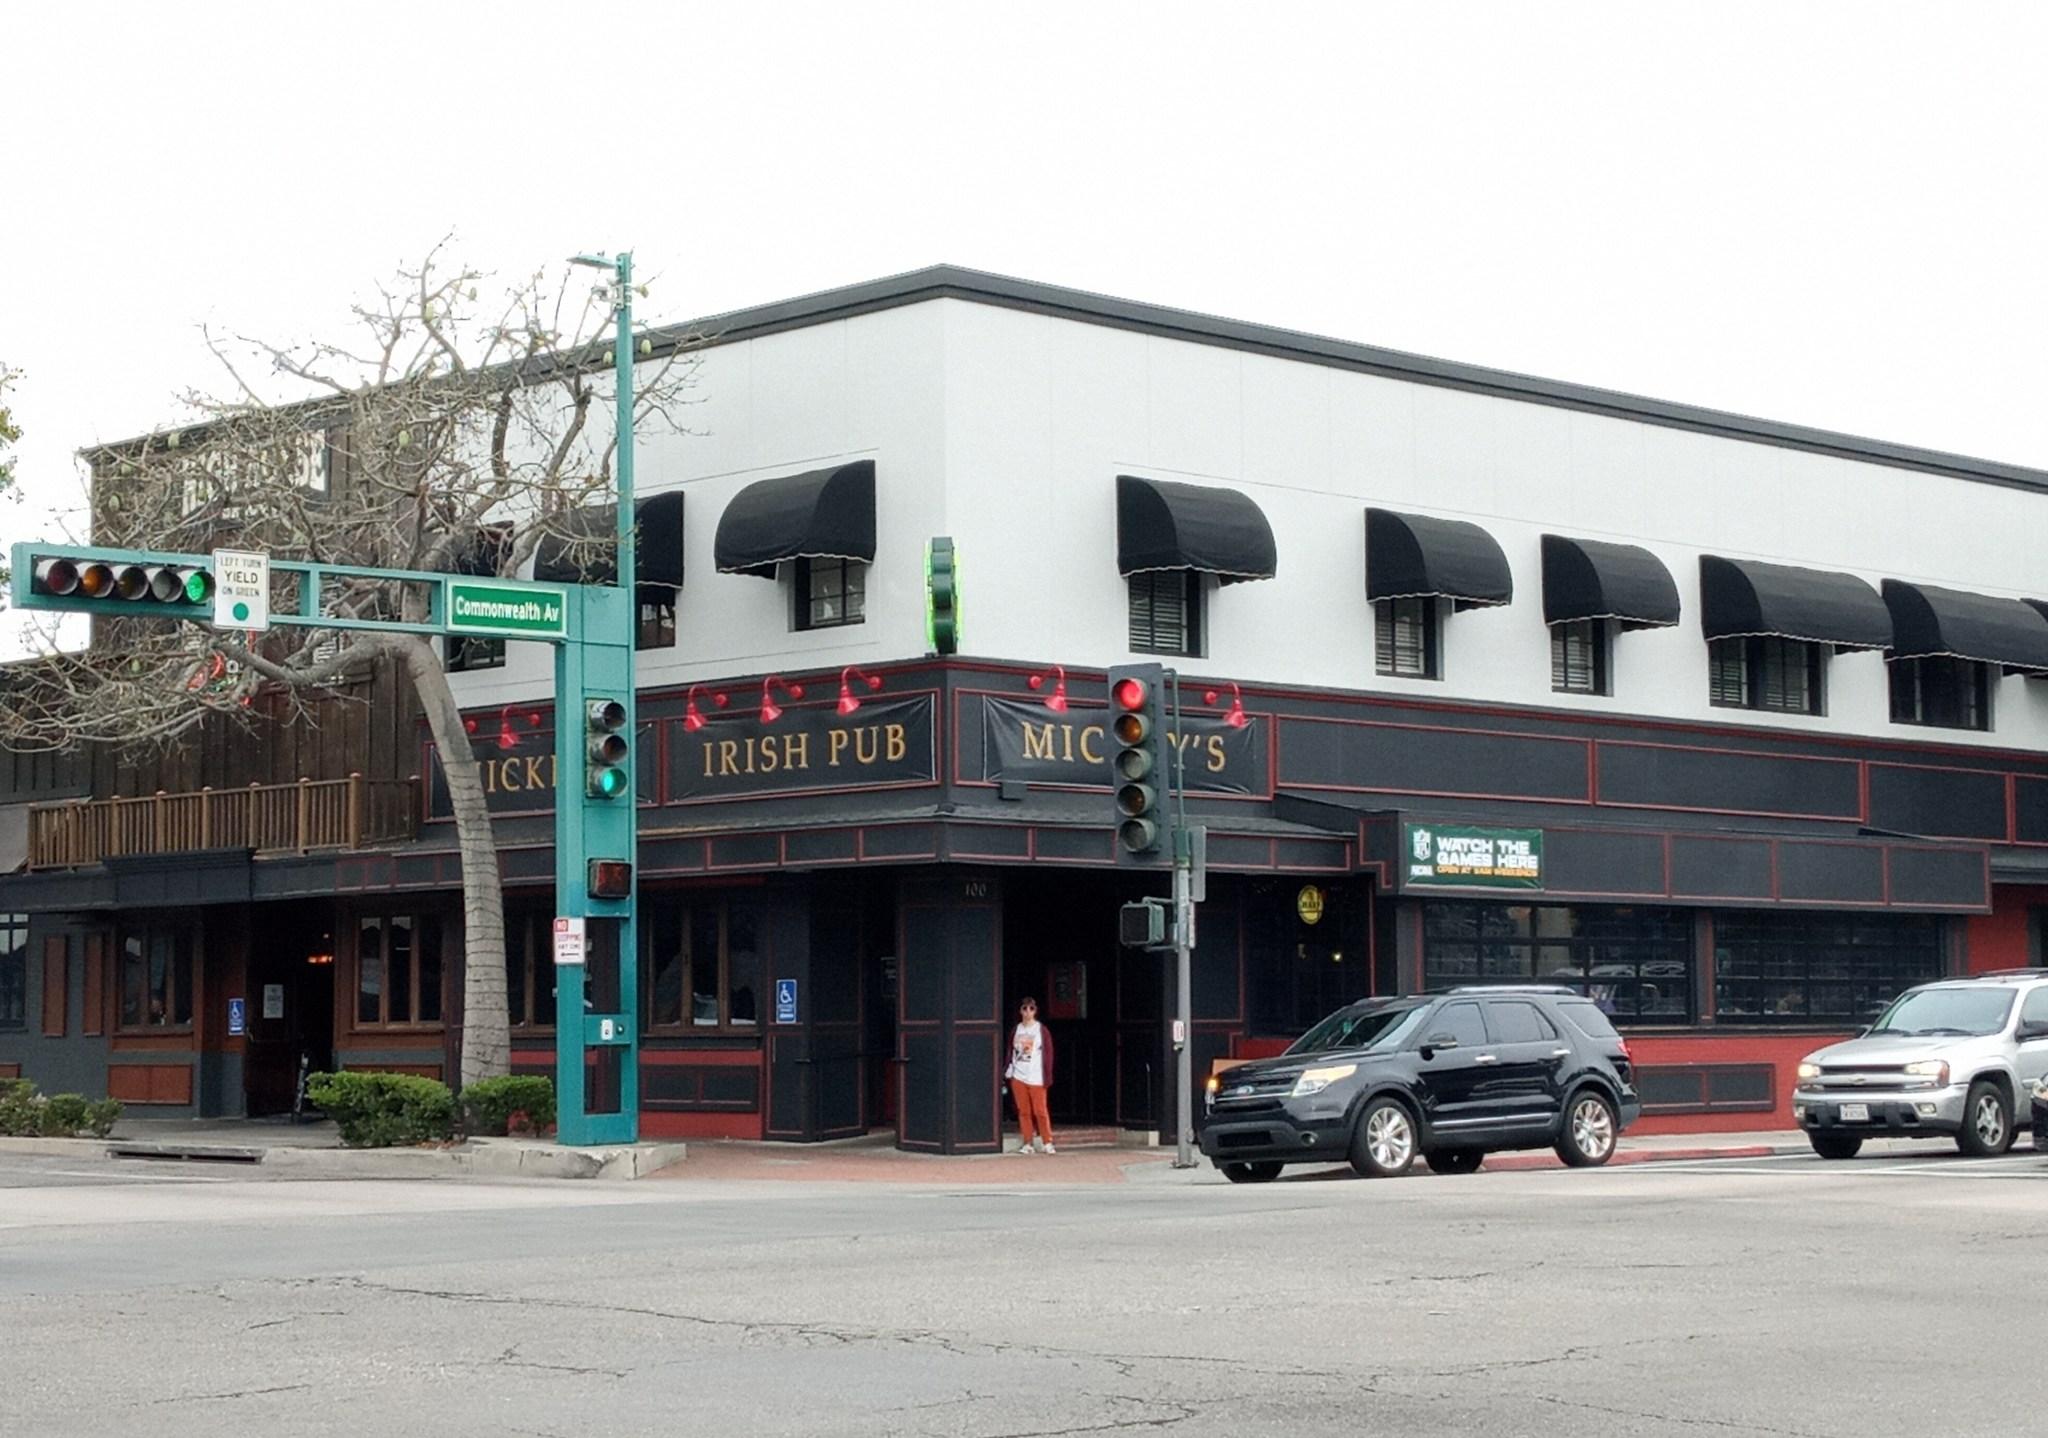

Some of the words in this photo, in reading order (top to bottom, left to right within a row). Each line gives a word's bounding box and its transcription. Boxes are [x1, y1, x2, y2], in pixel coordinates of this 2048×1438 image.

[220, 556, 239, 567] LEFT
[243, 558, 262, 568] TURN
[224, 570, 258, 584] YIELD
[222, 586, 233, 595] ON
[236, 586, 260, 596] GREEN
[455, 595, 541, 621] Commonwealth
[543, 602, 559, 622] Av
[703, 732, 810, 777] IRISH
[828, 724, 906, 767] PUB
[1021, 721, 1226, 772] MICY'S
[1436, 836, 1494, 853] WATCH
[1497, 839, 1530, 855] THE
[1436, 851, 1493, 867] GAMES
[1497, 854, 1538, 869] HERE
[965, 882, 987, 897] 100
